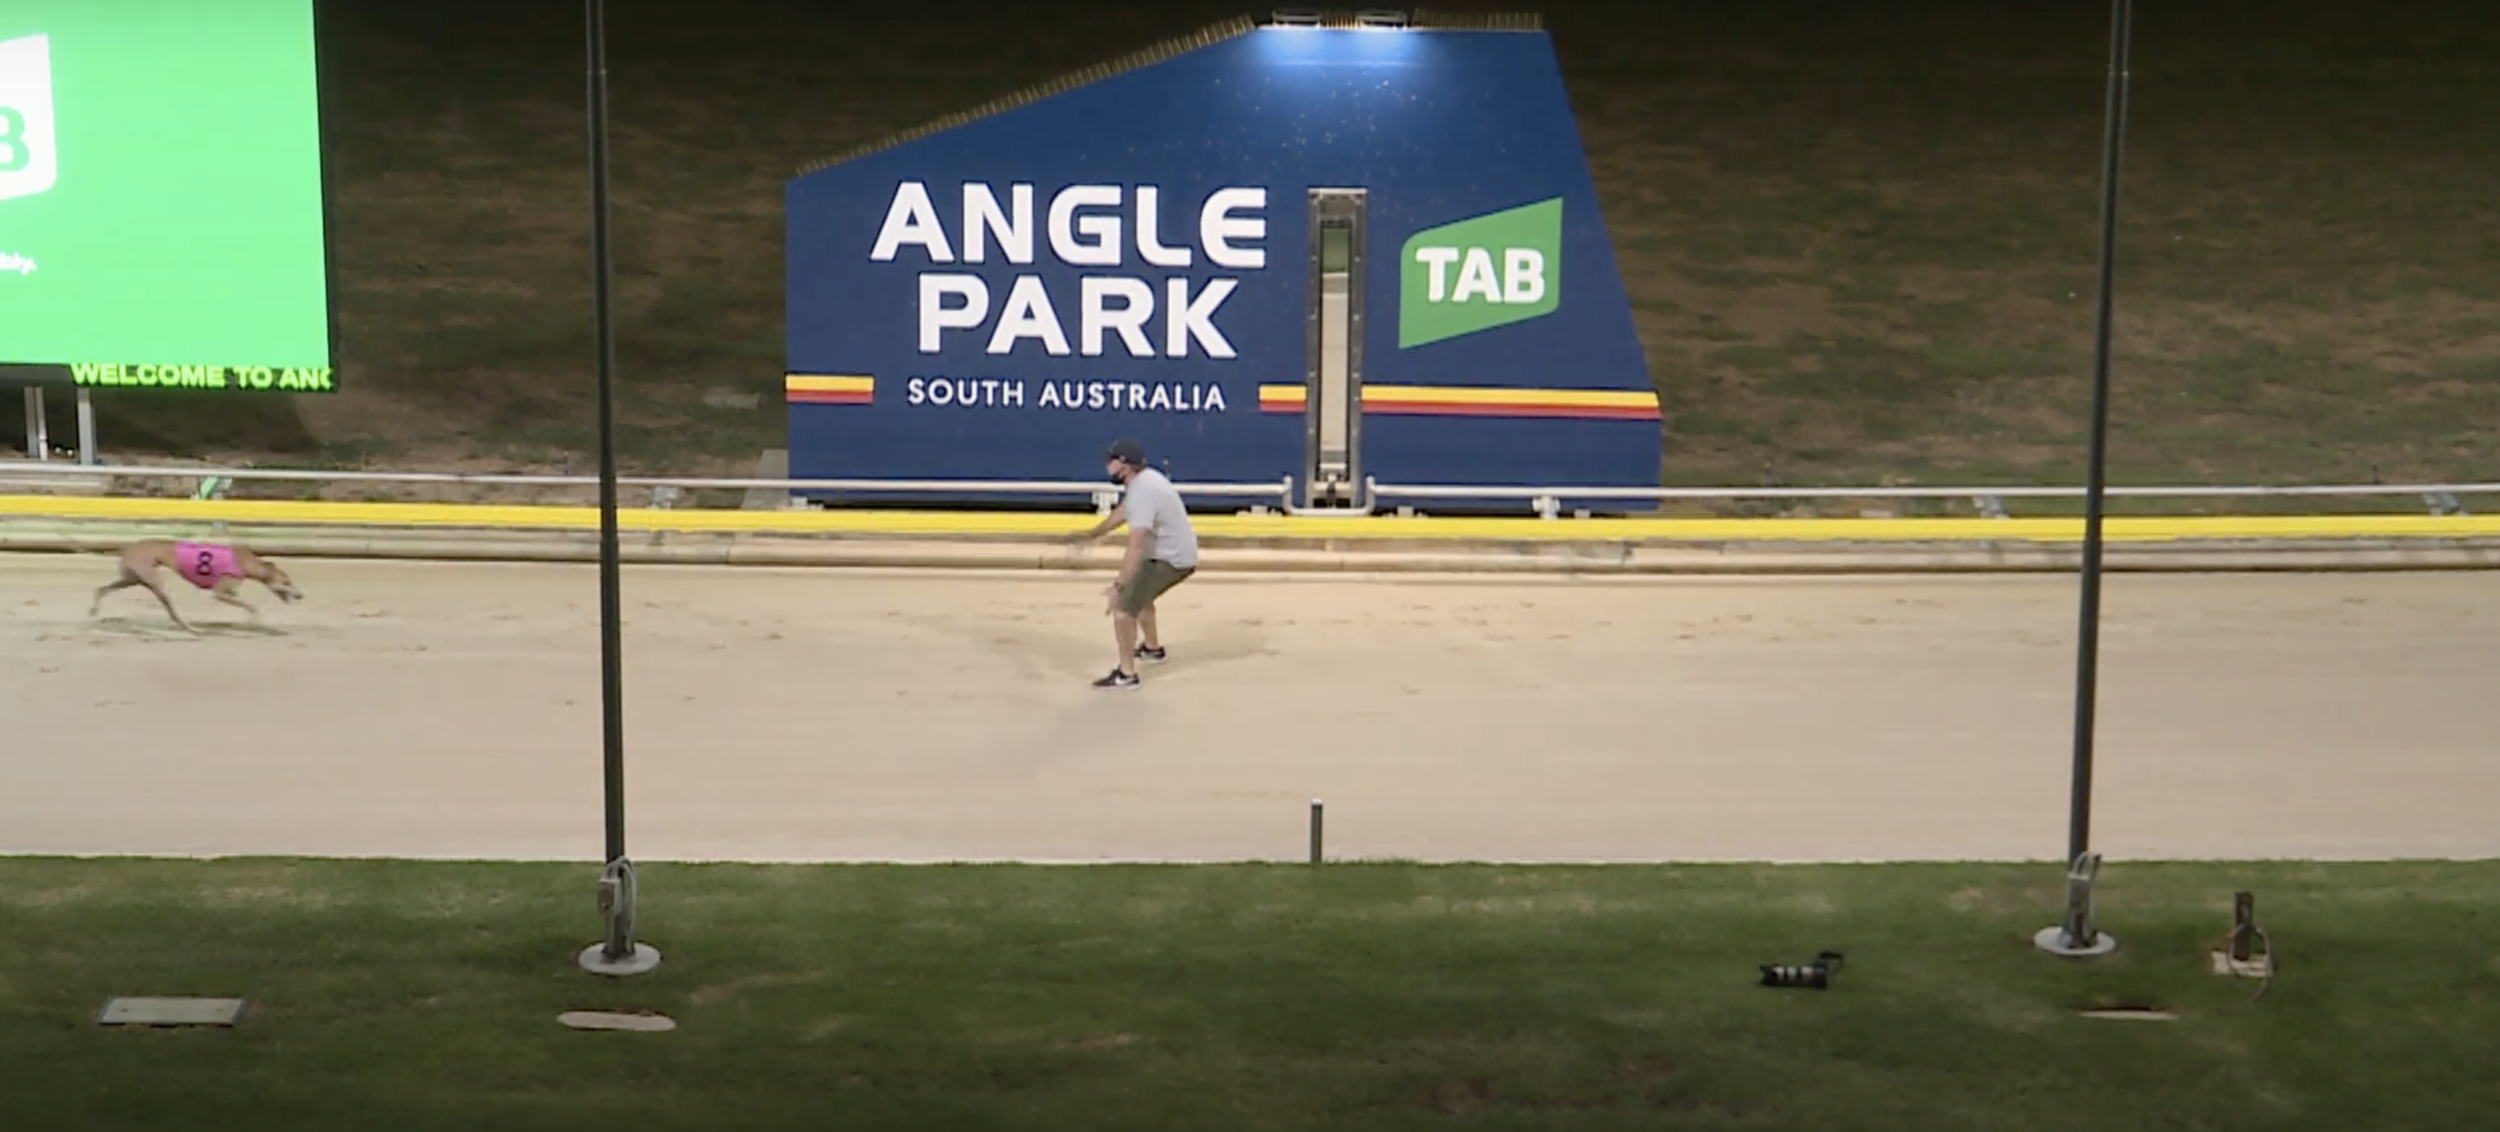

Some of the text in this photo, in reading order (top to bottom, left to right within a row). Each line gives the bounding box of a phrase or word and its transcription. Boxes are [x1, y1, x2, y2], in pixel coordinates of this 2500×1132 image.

[869, 181, 1267, 269] ANGLE
[1415, 246, 1545, 304] TAB
[917, 273, 1239, 359] PARK
[71, 363, 226, 387] WELCOME
[232, 367, 274, 389] TO
[907, 378, 1226, 412] SOUTH AUSTRALIA
[195, 551, 213, 576] 8
